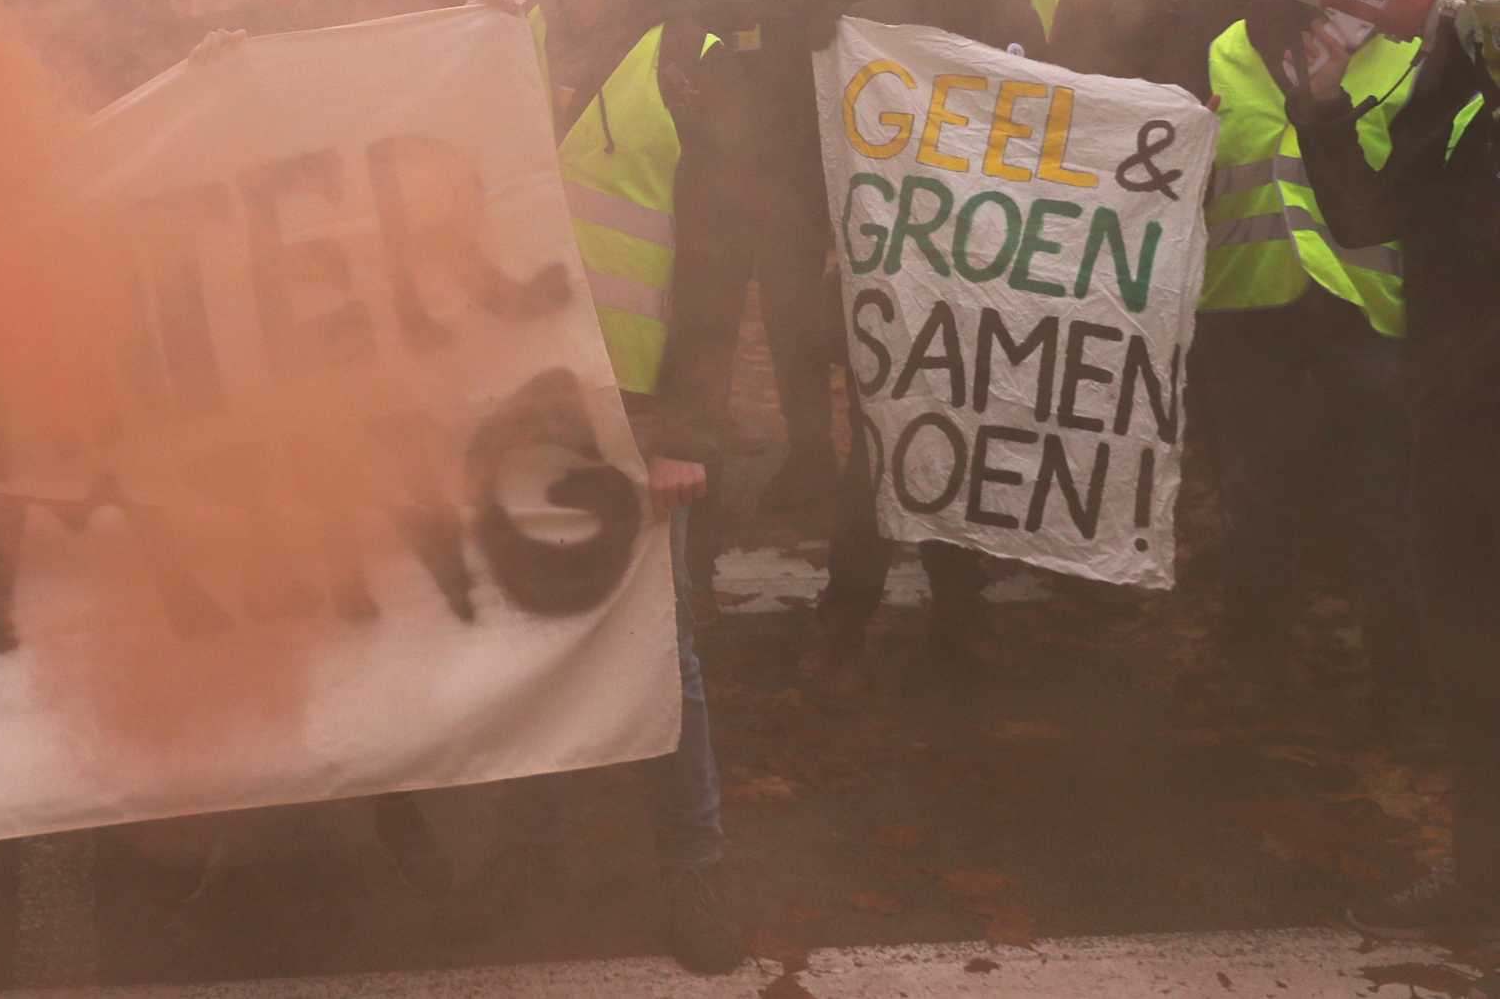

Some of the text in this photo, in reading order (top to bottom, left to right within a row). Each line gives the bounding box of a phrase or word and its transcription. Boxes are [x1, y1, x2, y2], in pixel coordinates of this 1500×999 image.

[841, 59, 1182, 200] GEEL &
[842, 172, 1163, 313] GROEN
[851, 288, 1181, 444] SAMEN
